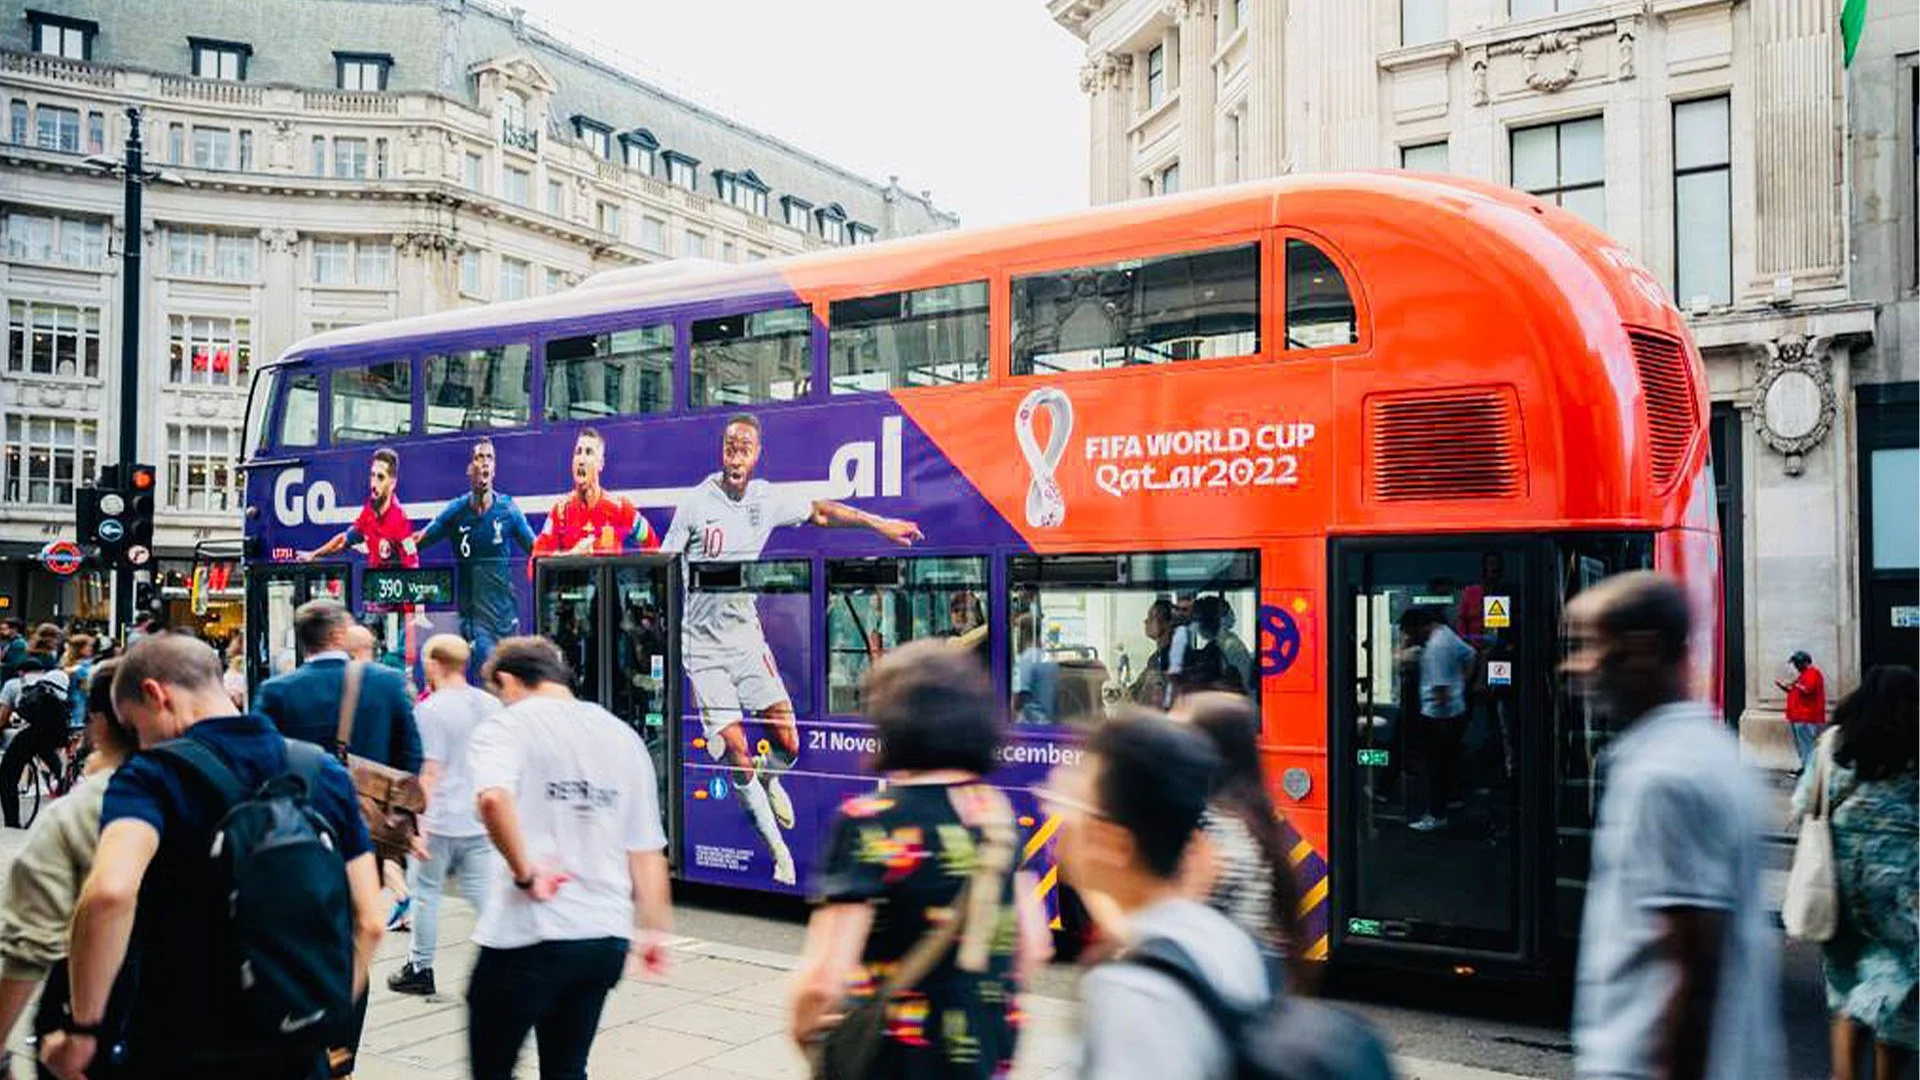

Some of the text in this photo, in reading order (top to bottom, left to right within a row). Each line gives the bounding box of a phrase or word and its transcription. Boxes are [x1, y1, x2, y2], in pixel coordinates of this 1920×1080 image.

[1085, 422, 1316, 460] FIFA WORLD CUP
[274, 415, 902, 527] Go al
[460, 533, 471, 558] 6
[703, 528, 723, 558] 10
[378, 579, 403, 598] 390
[808, 730, 827, 750] 21
